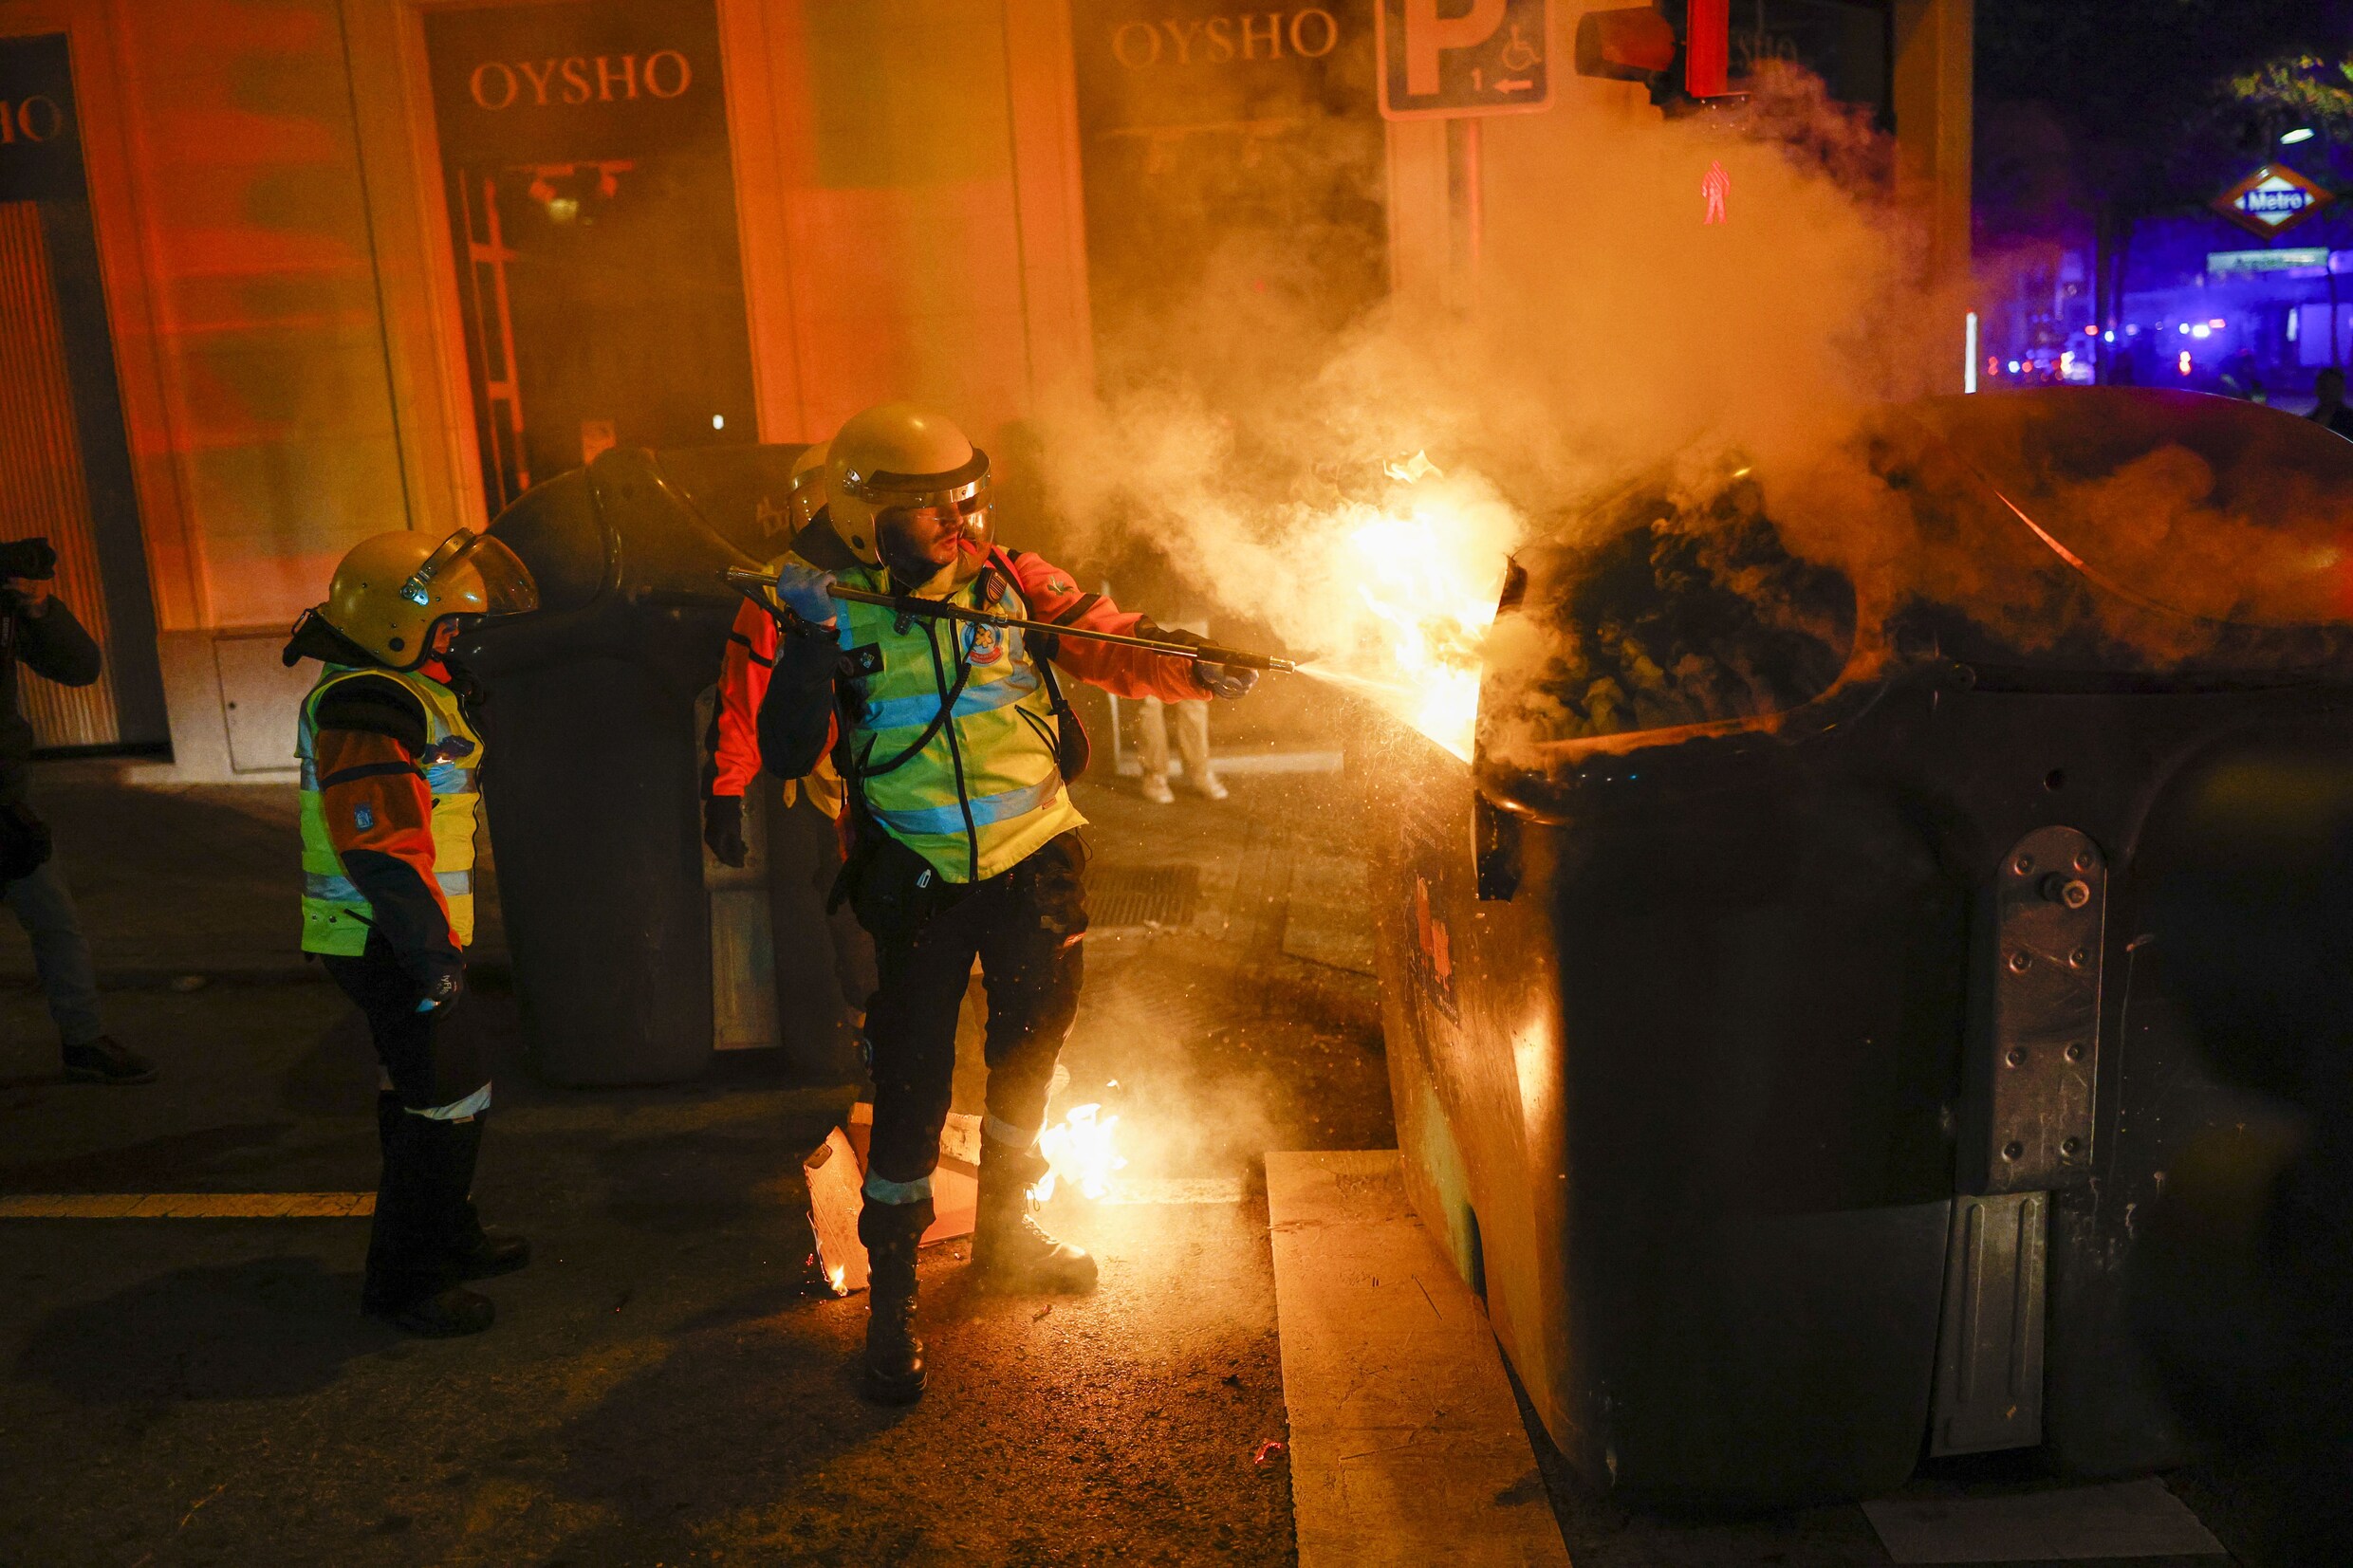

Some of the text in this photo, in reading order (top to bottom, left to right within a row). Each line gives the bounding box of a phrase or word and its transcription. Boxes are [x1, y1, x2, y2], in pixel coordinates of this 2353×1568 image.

[1111, 9, 1339, 71] OYSHO
[1406, 0, 1508, 95] P
[470, 50, 693, 111] OYSHO
[1472, 68, 1483, 92] 1
[2249, 191, 2303, 212] Metro
